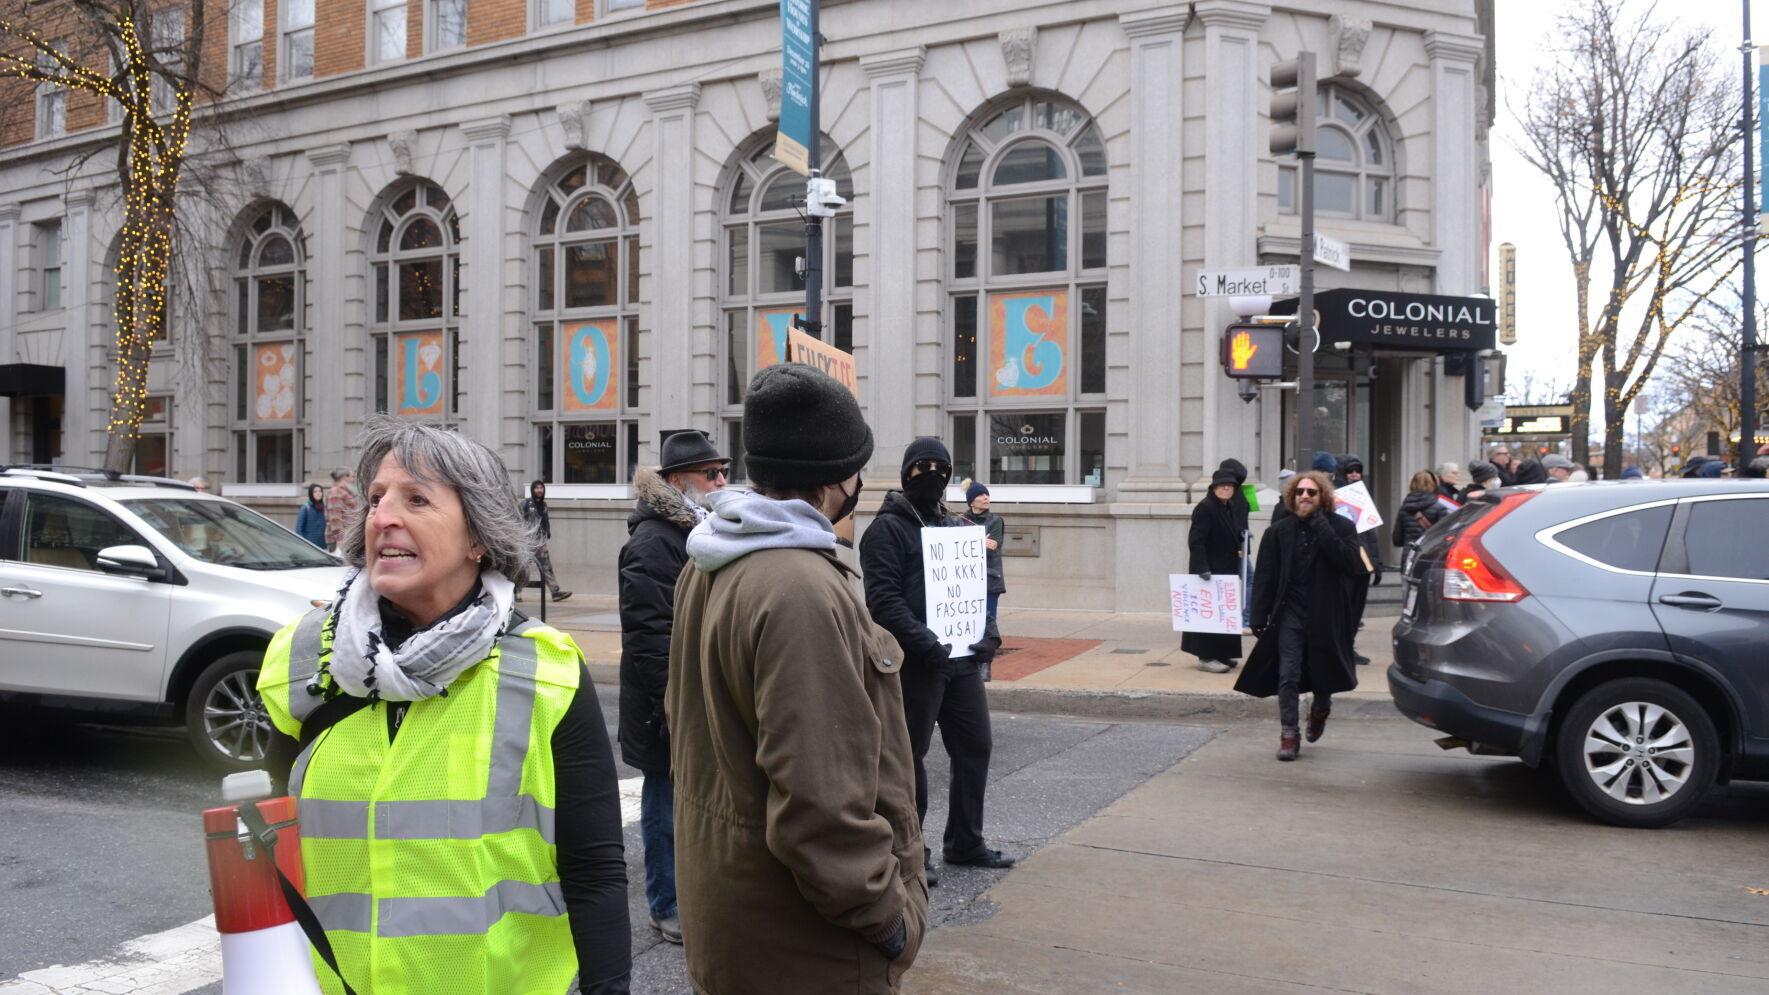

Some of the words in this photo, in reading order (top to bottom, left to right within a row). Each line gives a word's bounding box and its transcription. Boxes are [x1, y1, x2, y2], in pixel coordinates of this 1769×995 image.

[1269, 267, 1290, 279] 0-100
[1199, 275, 1210, 295] S.
[1217, 274, 1267, 295] Market
[1348, 298, 1491, 325] COLONIAL
[1371, 324, 1471, 340] JEWELERS
[568, 441, 612, 449] COLONIAL
[997, 436, 1058, 444] COLONIAL
[930, 542, 944, 560] NO
[955, 539, 984, 559] ICE!
[932, 566, 947, 582] NO
[955, 562, 984, 581] KKK!
[947, 584, 961, 598] NO
[936, 599, 985, 618] FASCIST
[1172, 590, 1183, 618] NOW
[1190, 594, 1199, 614] ICE
[1200, 589, 1213, 619] END
[945, 620, 976, 638] USA!
